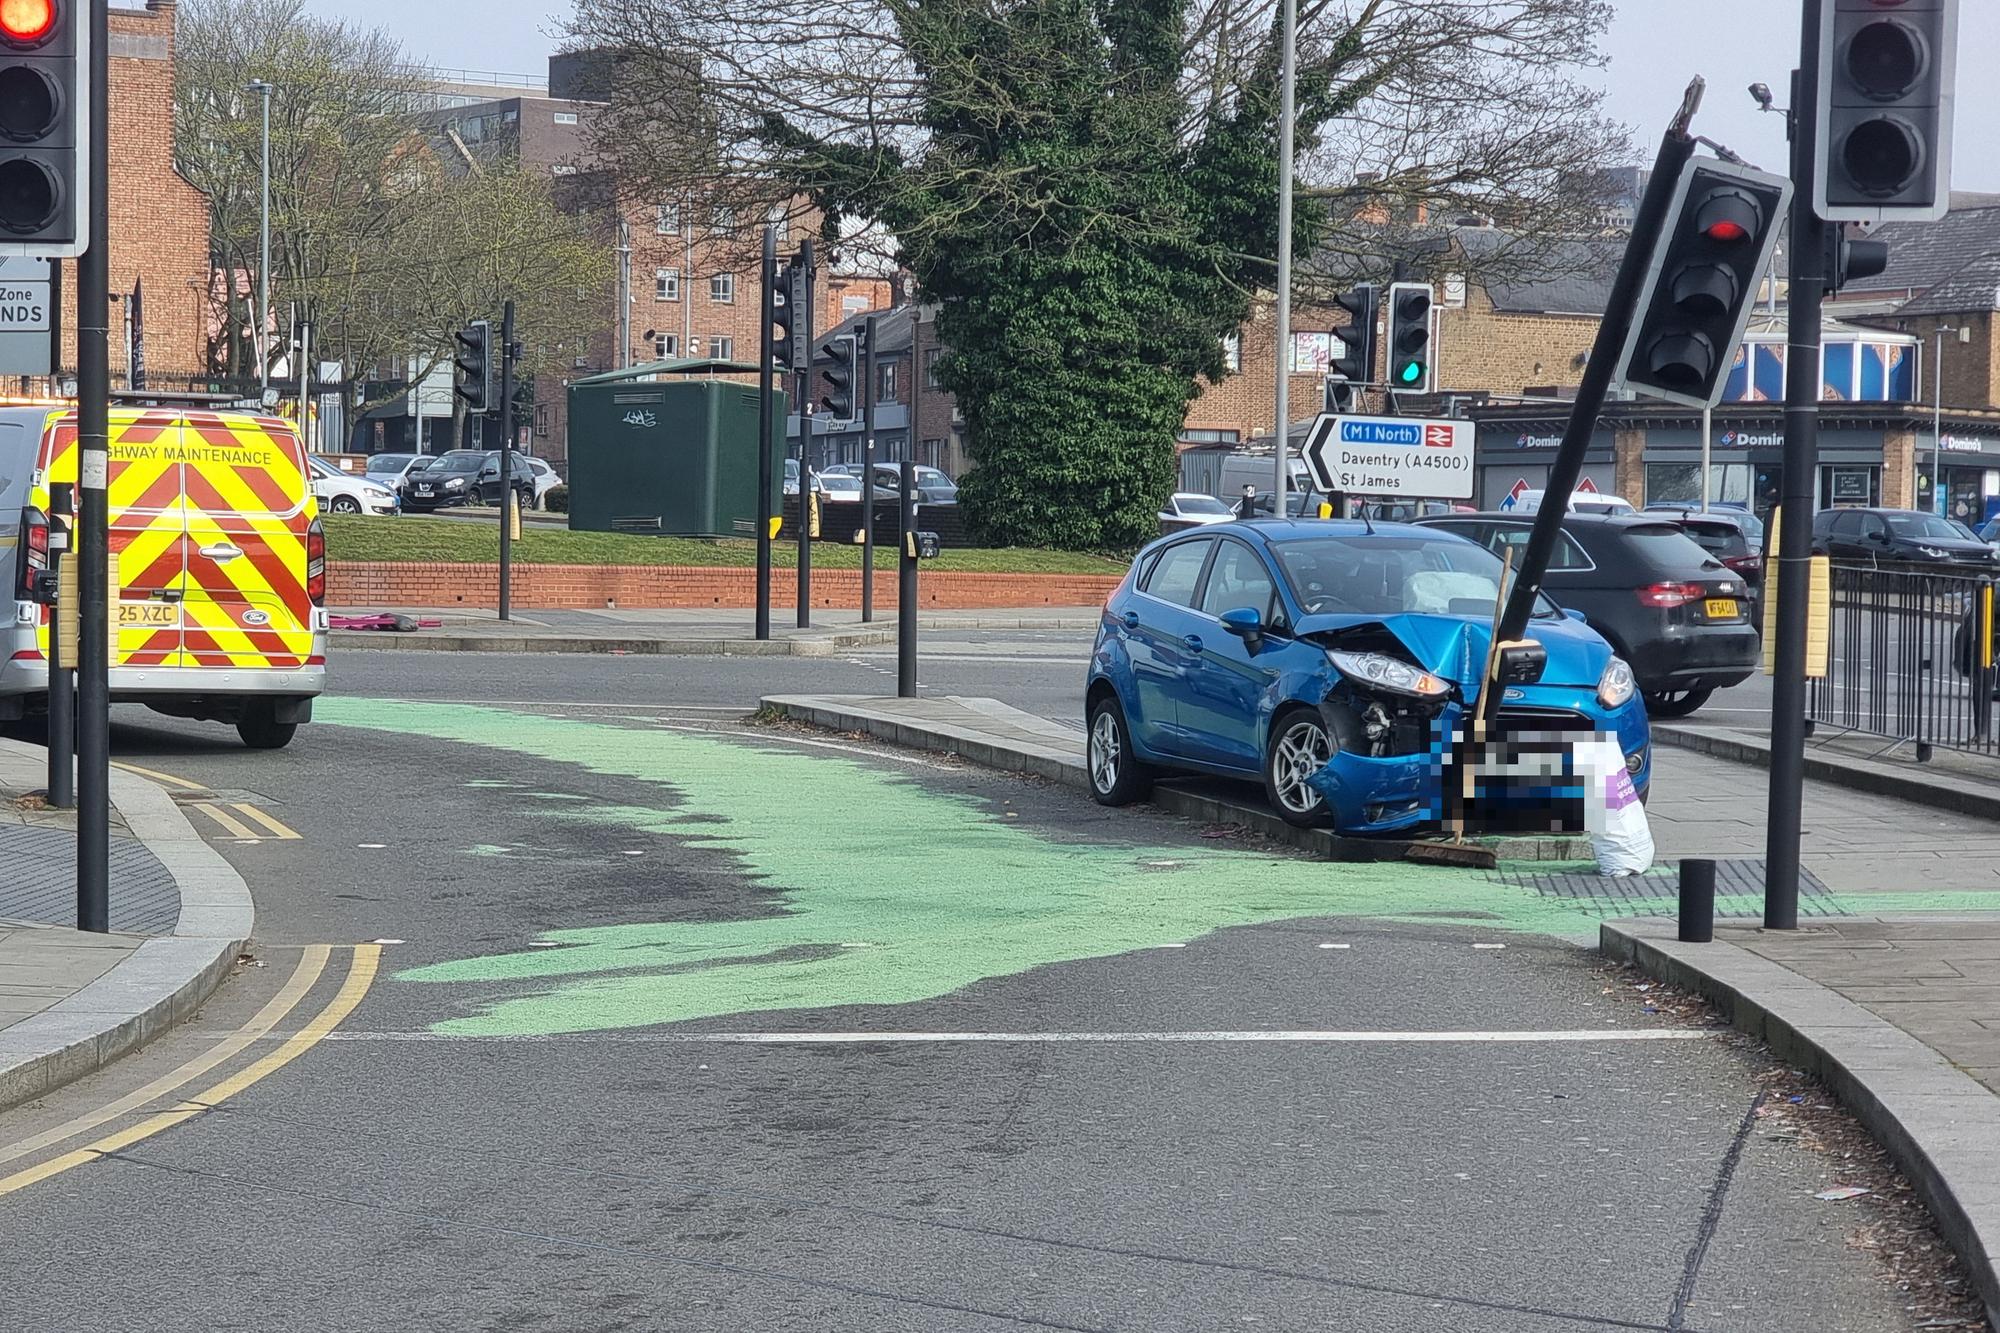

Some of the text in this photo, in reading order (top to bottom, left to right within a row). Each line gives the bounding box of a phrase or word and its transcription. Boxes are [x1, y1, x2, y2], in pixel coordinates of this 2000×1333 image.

[0, 287, 32, 301] Zone
[1343, 425, 1420, 442] (M1 North)
[1527, 434, 1563, 447] Domin
[1948, 436, 1982, 451] Domino's
[164, 447, 271, 464] MAINTENANCE
[1342, 451, 1469, 471] Daventry (A4500)
[1341, 473, 1400, 488] St James
[119, 606, 172, 621] 25 XZC
